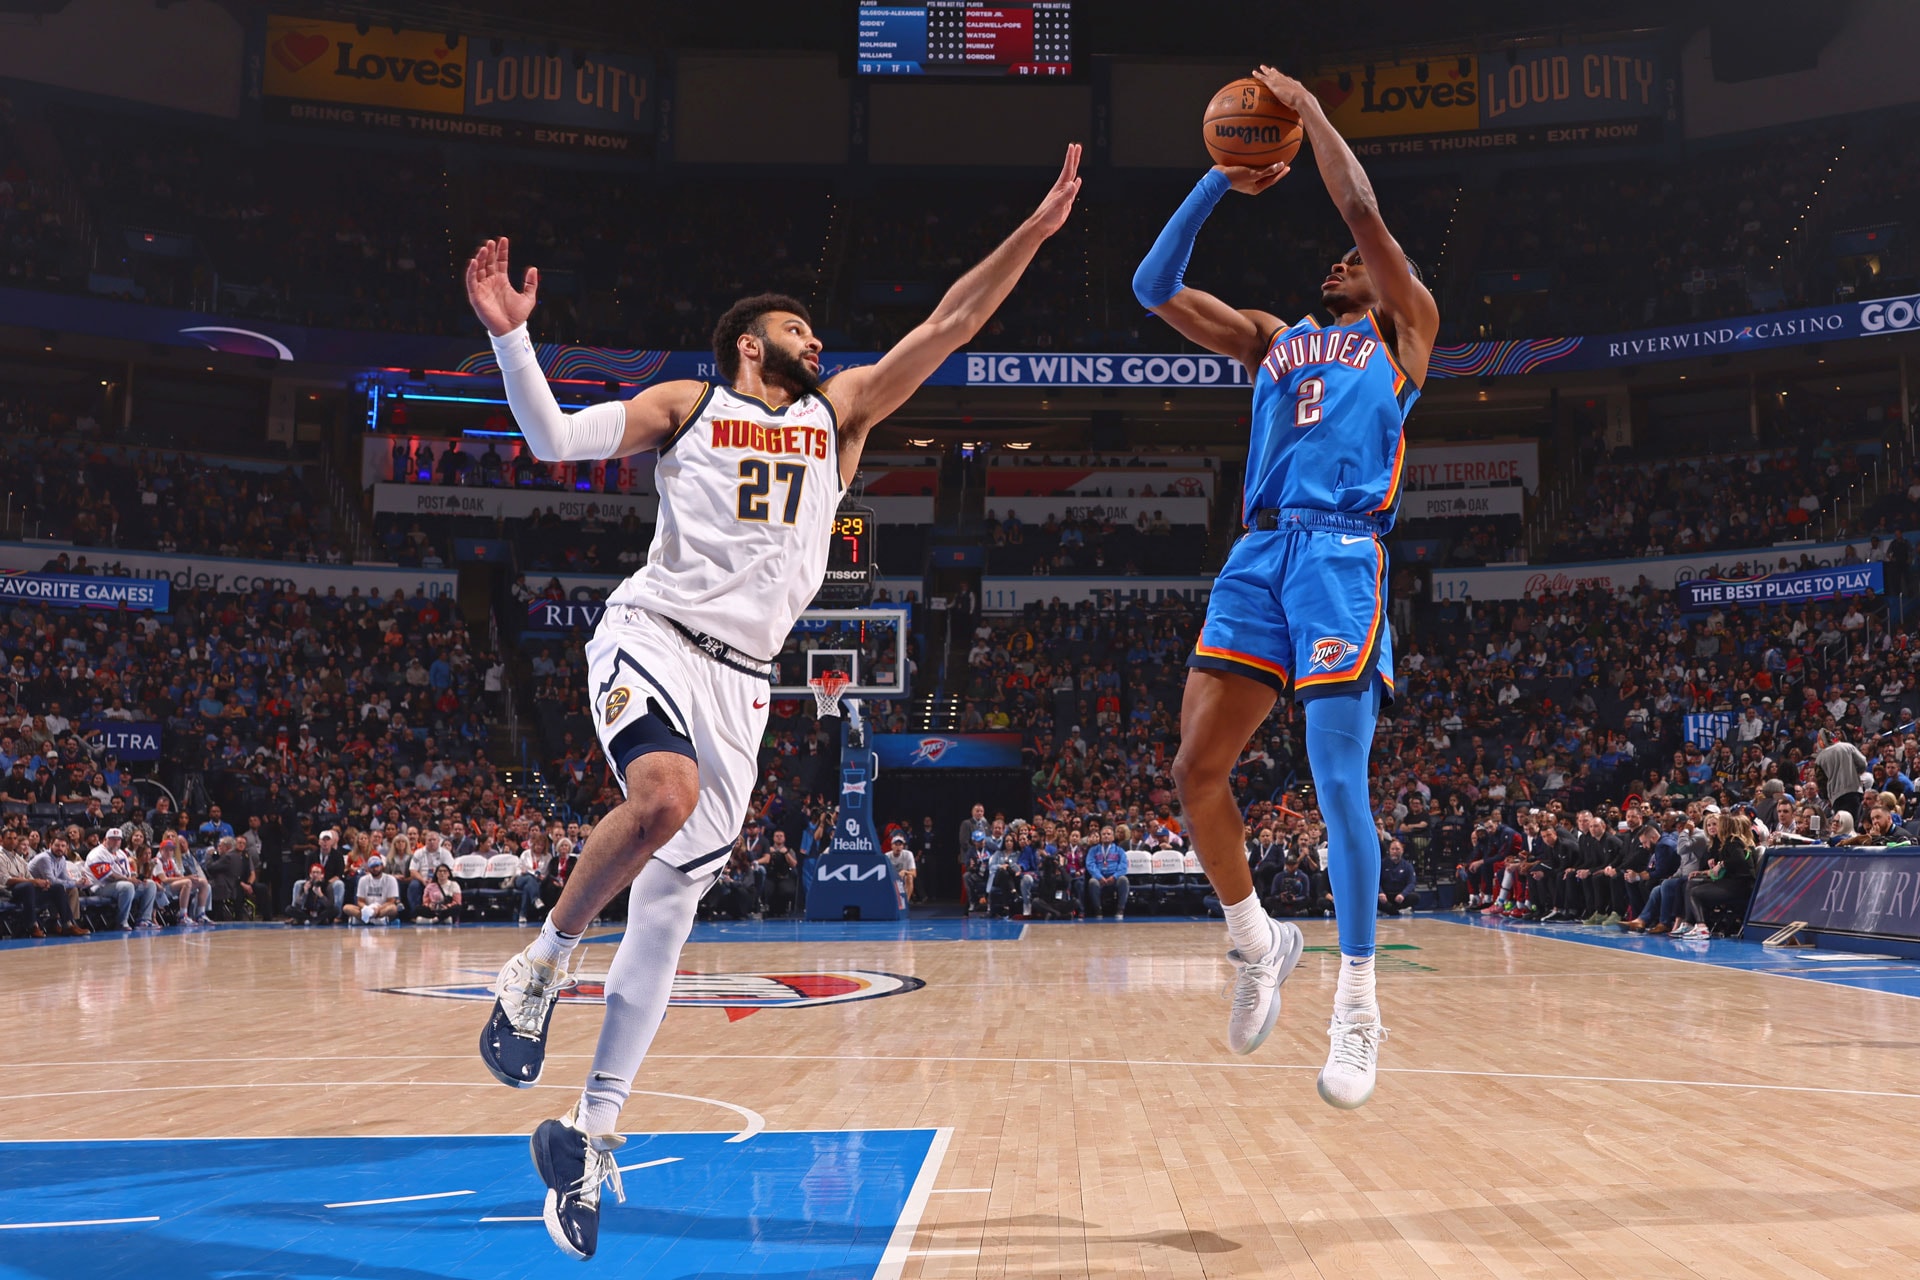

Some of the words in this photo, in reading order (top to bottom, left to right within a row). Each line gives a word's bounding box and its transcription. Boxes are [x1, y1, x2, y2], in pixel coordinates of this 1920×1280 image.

[862, 64, 871, 72] TO
[876, 64, 881, 72] 7
[1019, 66, 1028, 74] TO
[1033, 66, 1038, 74] 7
[475, 55, 564, 106] LOUD
[576, 59, 647, 121] CITY
[1487, 55, 1570, 118] LOUD
[1582, 53, 1654, 105] CITY
[290, 104, 355, 122] BRING
[361, 111, 401, 127] THE
[408, 115, 503, 138] THUNDER
[534, 129, 578, 145] EXIT
[584, 134, 628, 149] NOW
[1215, 124, 1281, 144] Wilson
[1352, 143, 1382, 156] ING
[1388, 140, 1424, 153] THE
[1429, 133, 1518, 150] THUNDER
[1547, 127, 1589, 142] EXIT
[1595, 123, 1639, 138] NOW
[1609, 328, 1734, 357] RIVERWIND
[1755, 314, 1842, 339] CASINO
[1262, 331, 1377, 384] THUNDER
[967, 356, 1021, 382] BIG
[1028, 356, 1114, 382] WINS
[1121, 357, 1221, 383] GOOD
[1294, 376, 1325, 428] 2
[711, 419, 828, 461] NUGGETS
[1444, 459, 1519, 482] TERRACE
[736, 457, 808, 526] 27
[417, 495, 445, 509] POST
[461, 497, 484, 511] OAK
[560, 502, 585, 515] POST
[601, 503, 624, 517] OAK
[1106, 506, 1128, 519] OAK
[1427, 499, 1453, 513] POST
[1468, 498, 1489, 512] OAK
[842, 535, 858, 562] 7
[826, 570, 867, 580] TISSOT
[1525, 573, 1574, 593] Bally
[84, 585, 154, 602] GAMES!
[1436, 580, 1469, 599] 112
[1691, 587, 1722, 603] THE
[1726, 583, 1762, 600] BEST
[1766, 579, 1812, 597] PLACE
[1814, 576, 1834, 593] TO
[1837, 572, 1872, 591] PLAY
[985, 589, 1017, 608] 111
[1314, 643, 1341, 663] OKC
[834, 837, 872, 851] Health
[1821, 870, 1920, 919] RIVER
